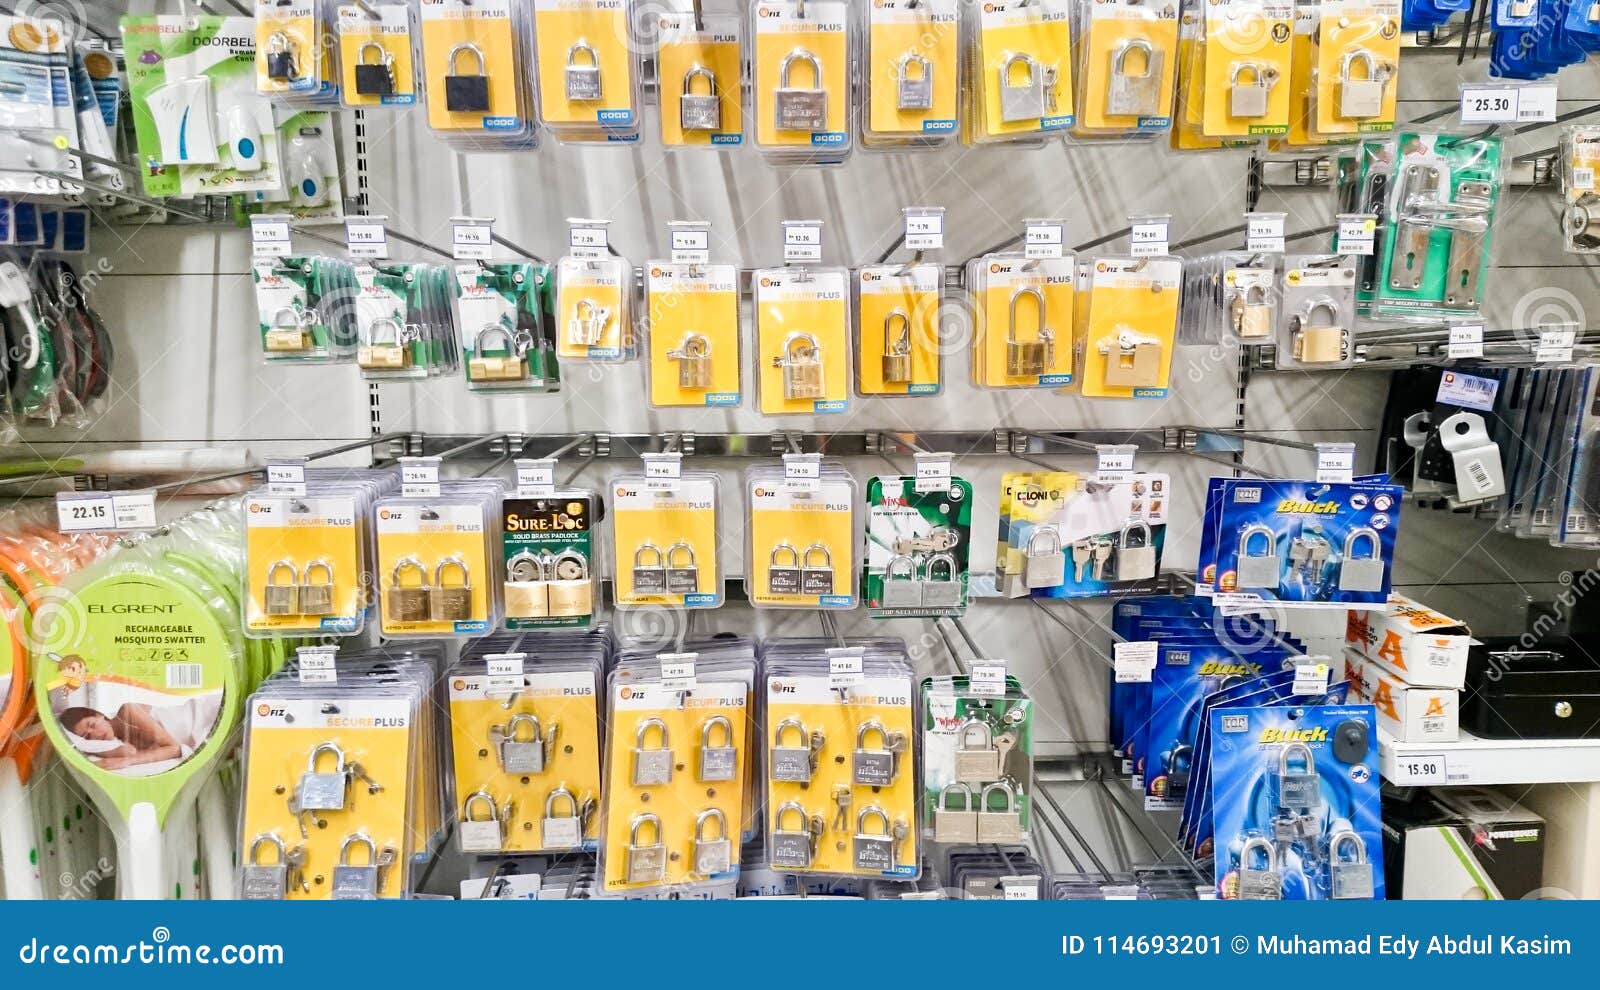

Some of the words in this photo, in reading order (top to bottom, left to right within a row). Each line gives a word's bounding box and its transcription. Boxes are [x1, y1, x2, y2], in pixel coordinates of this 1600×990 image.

[192, 37, 256, 47] DOORBEL
[1475, 98, 1509, 112] 25.30
[1275, 499, 1341, 514] Buick
[73, 506, 105, 519] 22.15
[87, 604, 177, 614] ELGRENT
[125, 624, 193, 633] RECHARGEABLE
[114, 636, 163, 645] MOSQUITO
[163, 636, 206, 644] SWATTER
[326, 717, 405, 728] SECUREPLUS
[1259, 726, 1329, 743] Buick
[1407, 763, 1437, 775] 15.90
